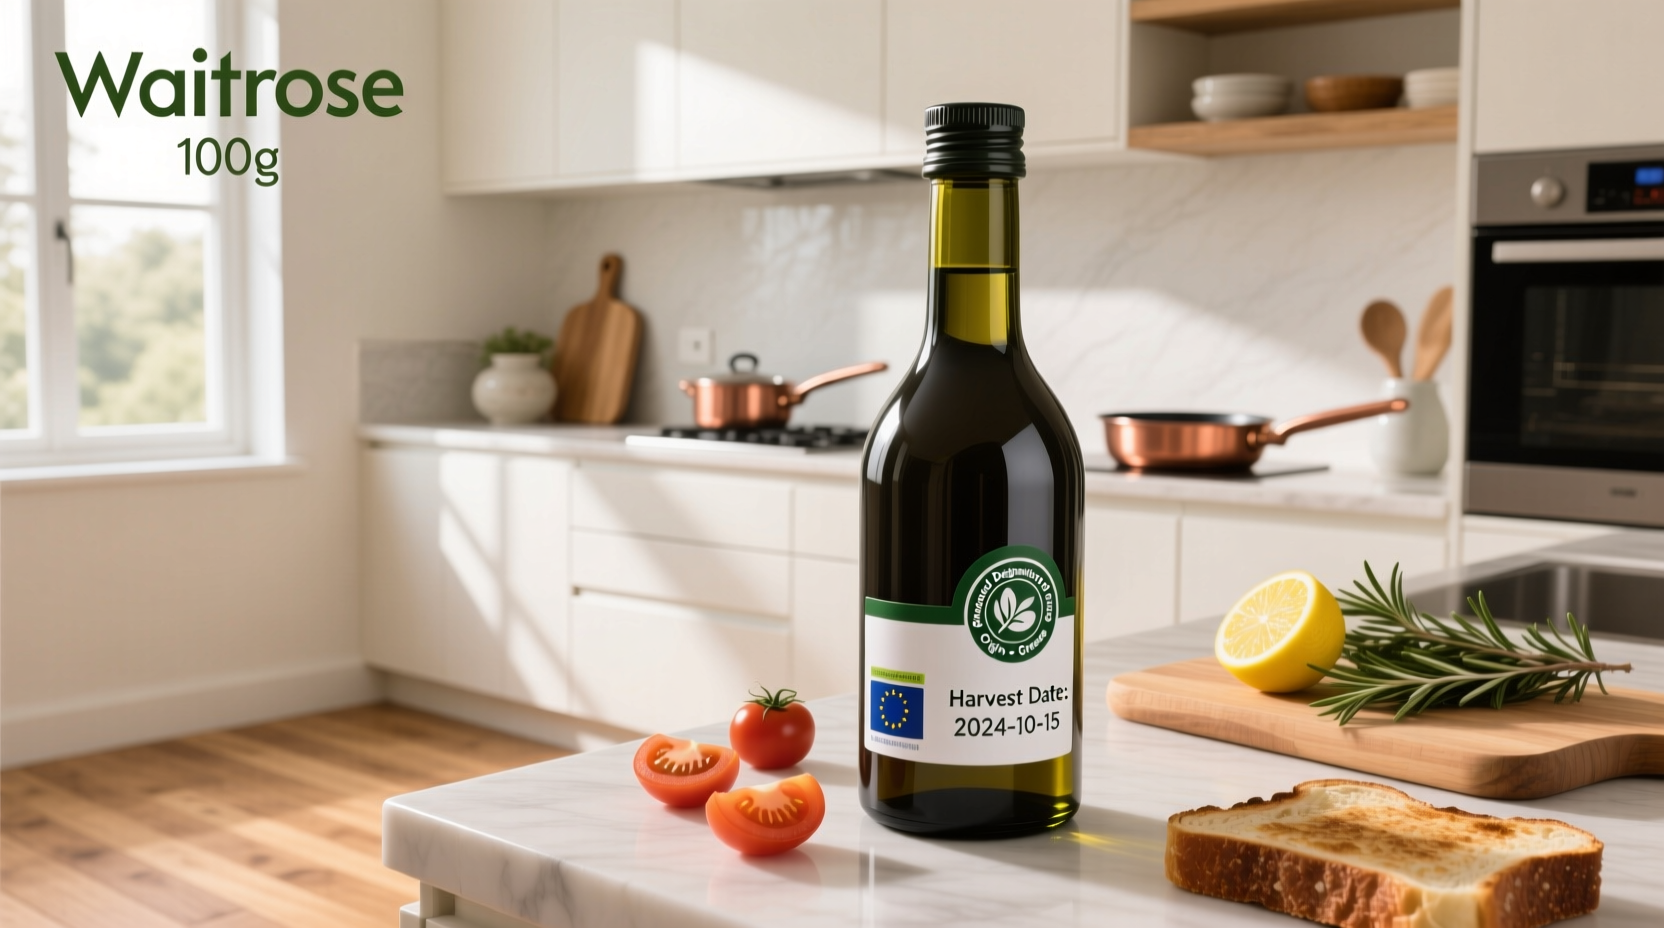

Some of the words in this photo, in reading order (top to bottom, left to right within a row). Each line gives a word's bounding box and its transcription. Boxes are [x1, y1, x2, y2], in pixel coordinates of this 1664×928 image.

[949, 688, 1024, 708] Harvest
[1028, 685, 1069, 705] Date:
[954, 711, 1060, 737] 2024-10-15
